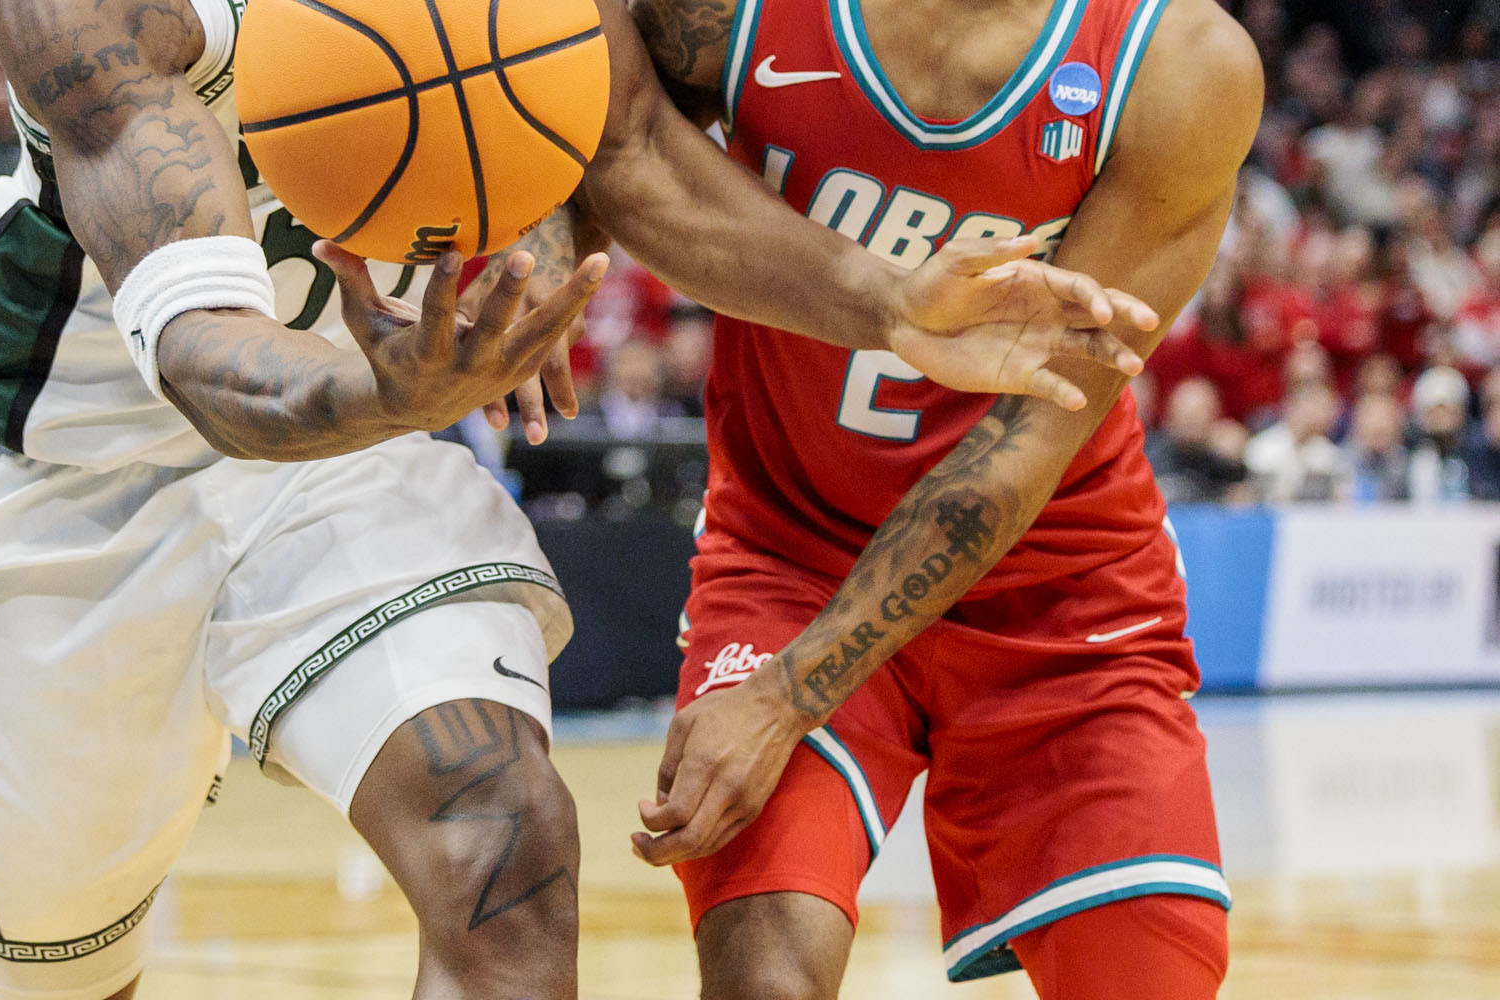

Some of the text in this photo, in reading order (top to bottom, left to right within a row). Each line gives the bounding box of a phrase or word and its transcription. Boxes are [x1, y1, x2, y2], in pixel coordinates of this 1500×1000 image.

[1055, 84, 1098, 106] NCAA
[835, 349, 927, 443] 2
[803, 552, 952, 700] FEAR GOD
